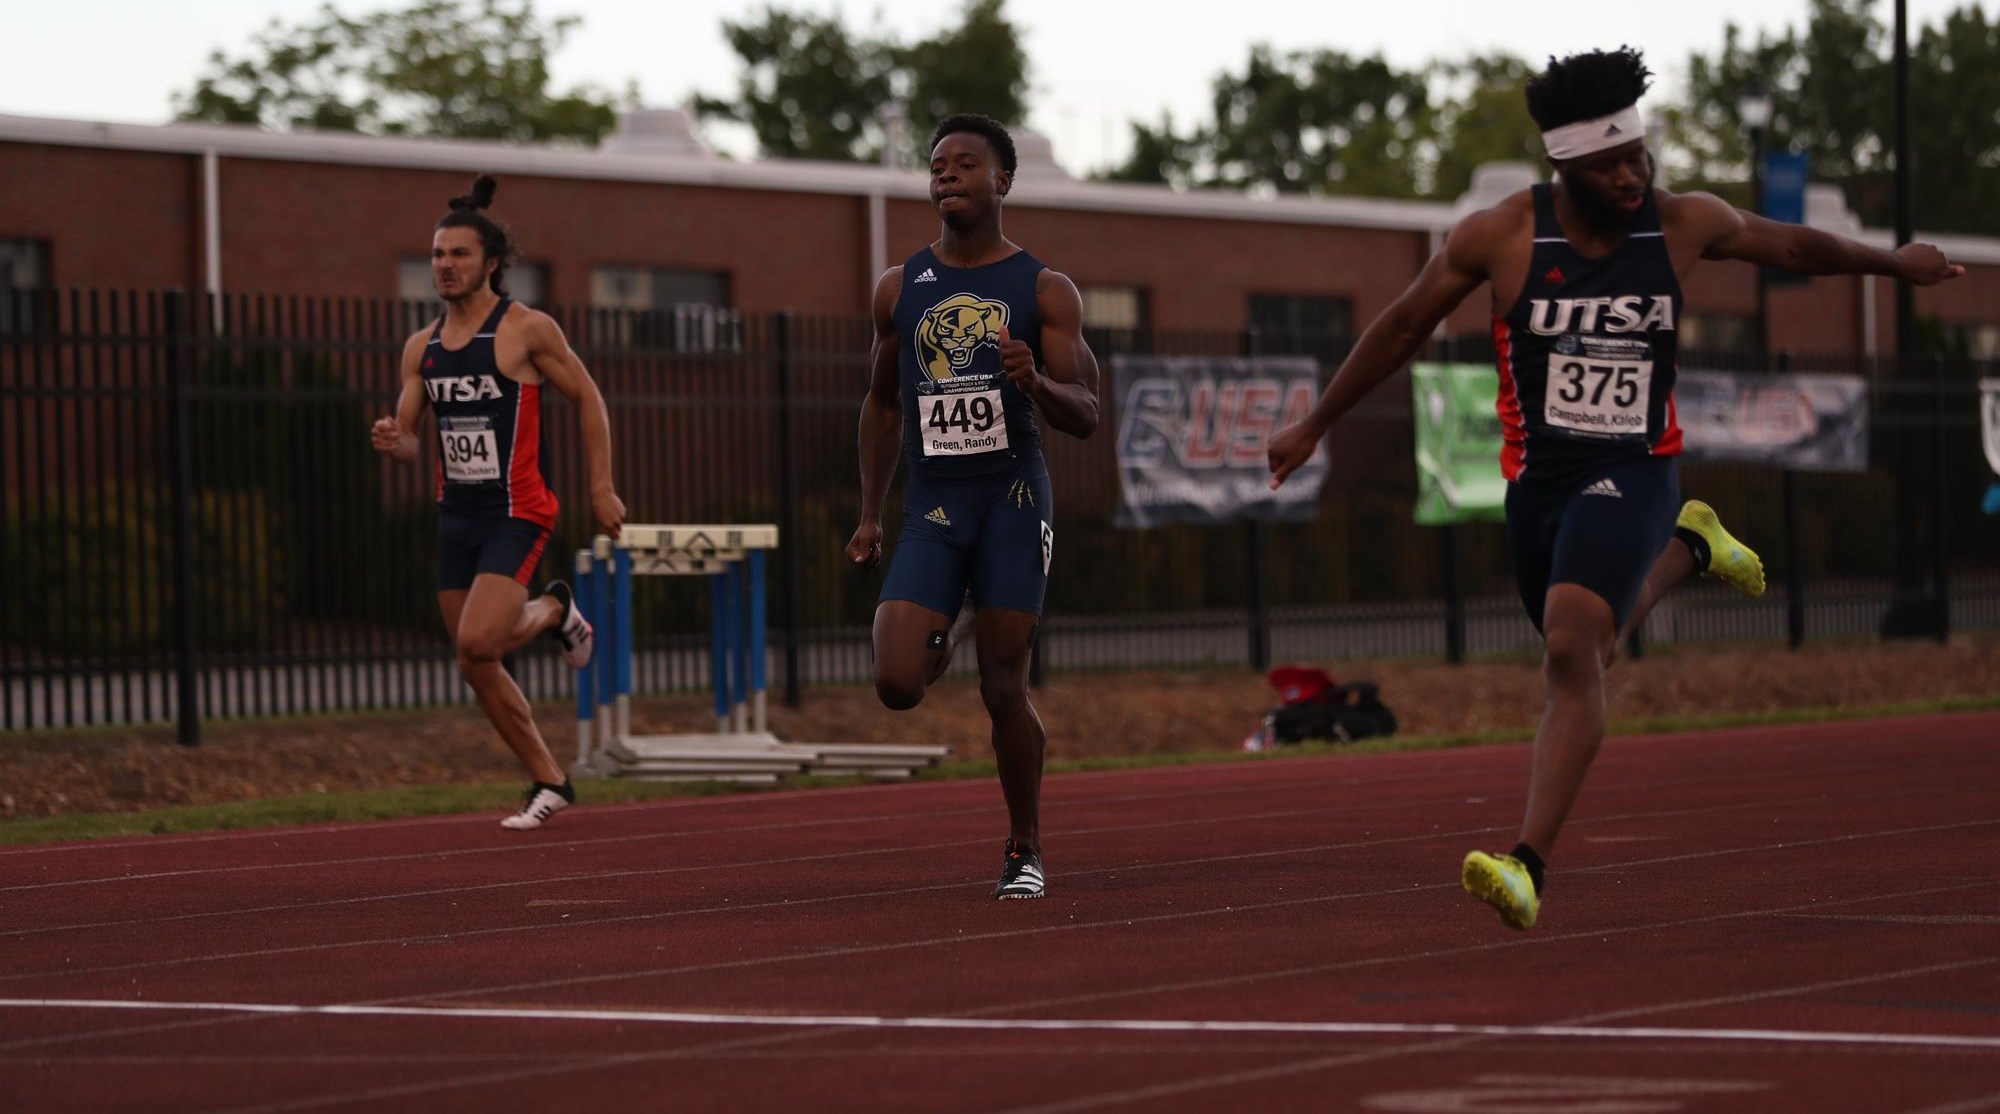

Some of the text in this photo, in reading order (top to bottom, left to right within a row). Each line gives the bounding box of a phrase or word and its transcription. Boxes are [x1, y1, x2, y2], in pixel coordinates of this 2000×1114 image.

[914, 276, 938, 284] adidas
[1528, 294, 1676, 337] UTSA
[937, 375, 979, 384] CONFERENCE
[1559, 362, 1639, 408] 375
[928, 396, 994, 434] 449
[1548, 406, 1643, 427] Campbell, Kaleb
[446, 435, 489, 462] 394
[932, 435, 997, 451] Green, Randy
[924, 514, 951, 526] adidas
